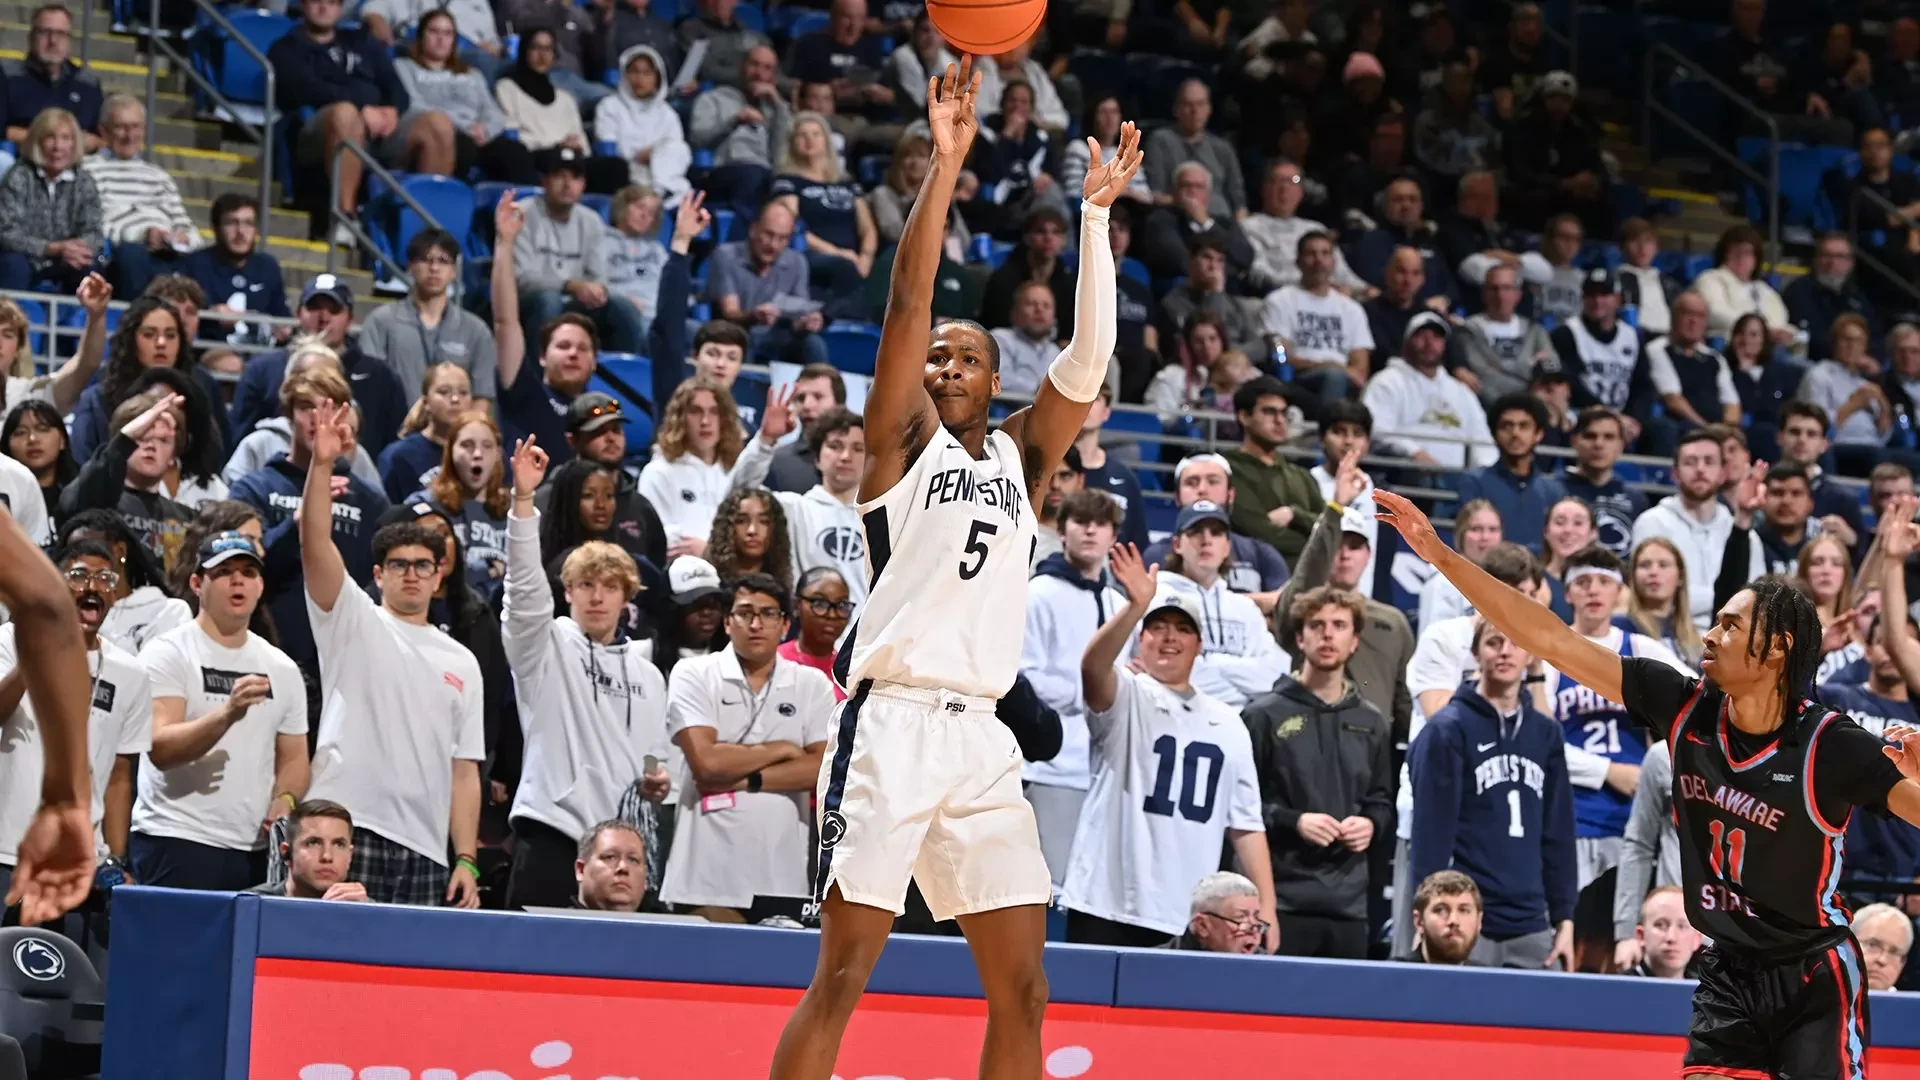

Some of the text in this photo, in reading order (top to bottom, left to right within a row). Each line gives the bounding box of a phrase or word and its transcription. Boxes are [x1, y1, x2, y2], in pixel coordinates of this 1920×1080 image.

[959, 519, 998, 580] 5
[944, 701, 967, 713] PSU
[1582, 718, 1622, 755] 21
[1142, 733, 1226, 825] 10
[1679, 774, 1786, 833] DELAWARE
[1507, 788, 1525, 838] 1
[1708, 818, 1747, 887] 11
[800, 902, 821, 917] DV
